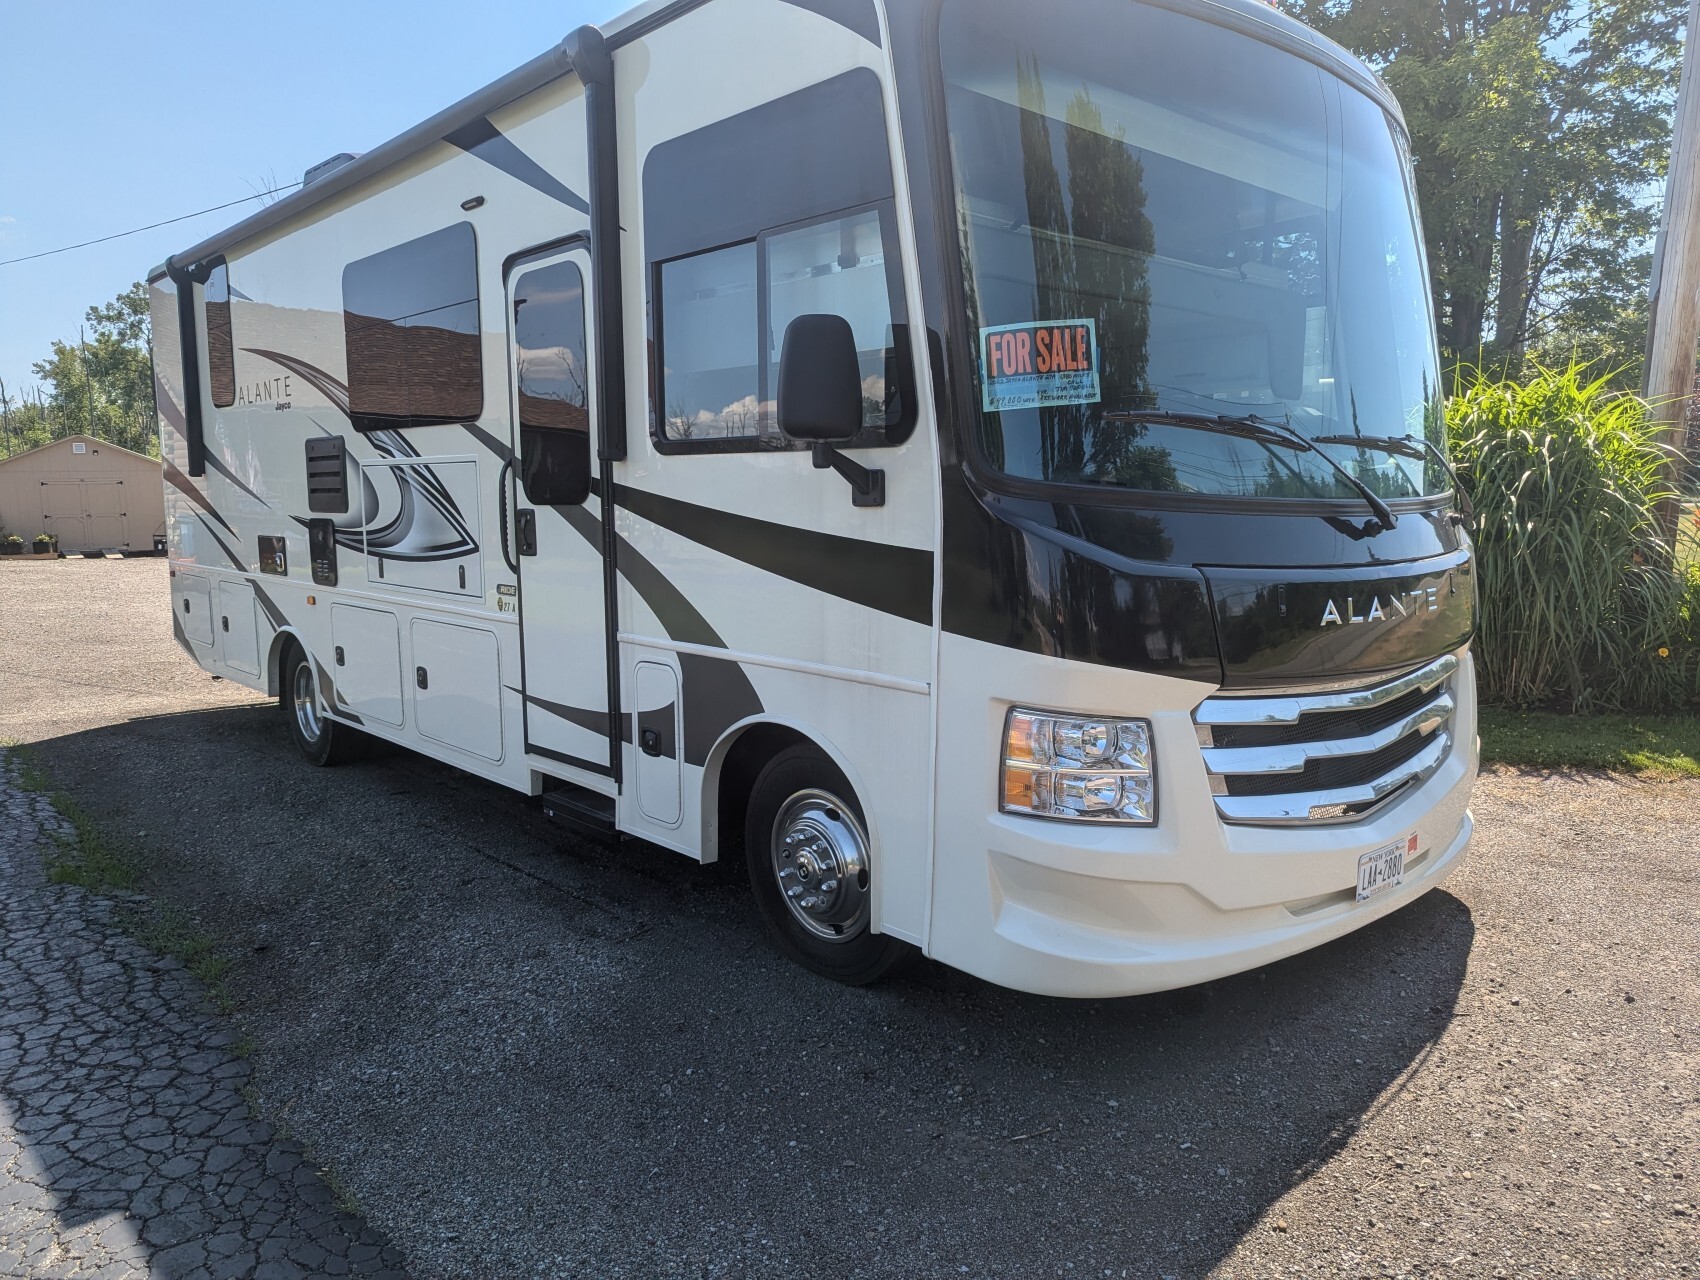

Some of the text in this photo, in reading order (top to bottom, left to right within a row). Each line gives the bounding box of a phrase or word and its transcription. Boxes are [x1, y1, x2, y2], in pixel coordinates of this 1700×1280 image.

[990, 327, 1088, 376] FOR SALE
[238, 376, 292, 406] ALANTE
[275, 401, 292, 412] Jayco
[503, 601, 511, 612] 27
[1320, 587, 1438, 626] ALANTE
[1371, 847, 1396, 864] NEW YORK
